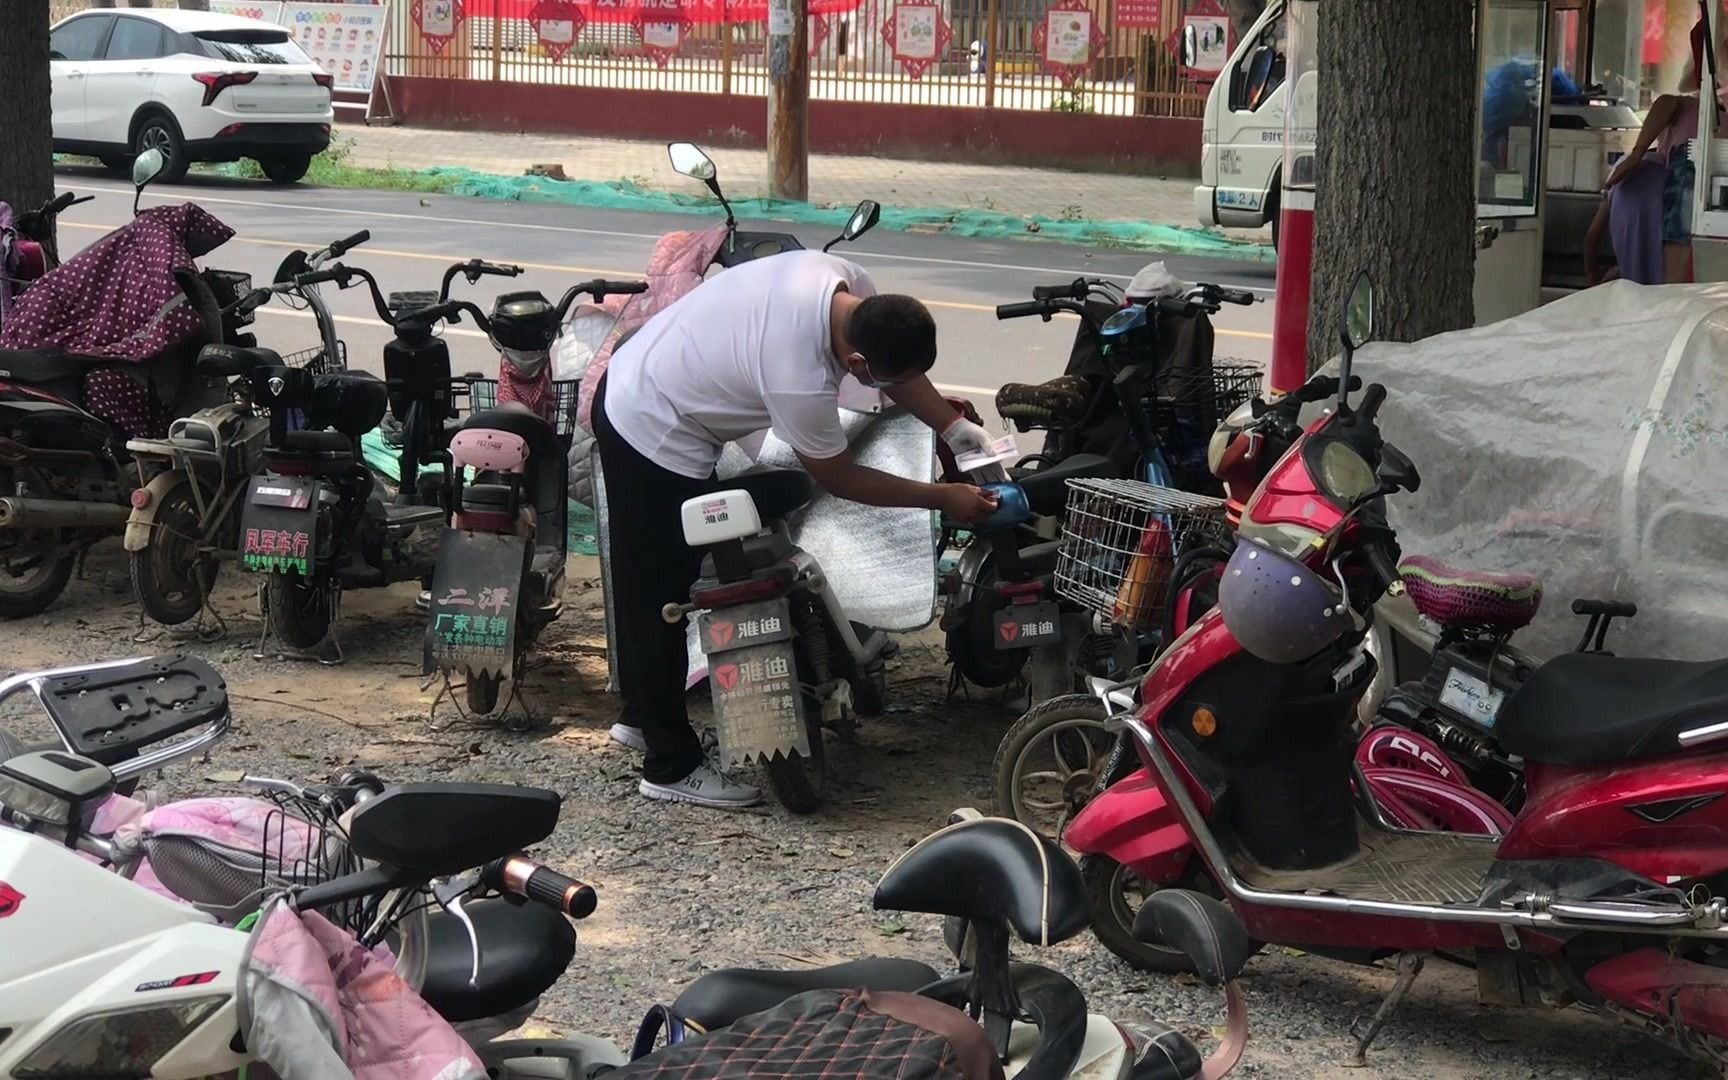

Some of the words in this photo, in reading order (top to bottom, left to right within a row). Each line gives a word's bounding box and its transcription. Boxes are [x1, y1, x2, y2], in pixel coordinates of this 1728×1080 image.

[434, 613, 508, 636] 厂家直销
[737, 616, 782, 639] 雅迪
[1021, 620, 1055, 637] 雅迪
[739, 655, 790, 685] 雅迪
